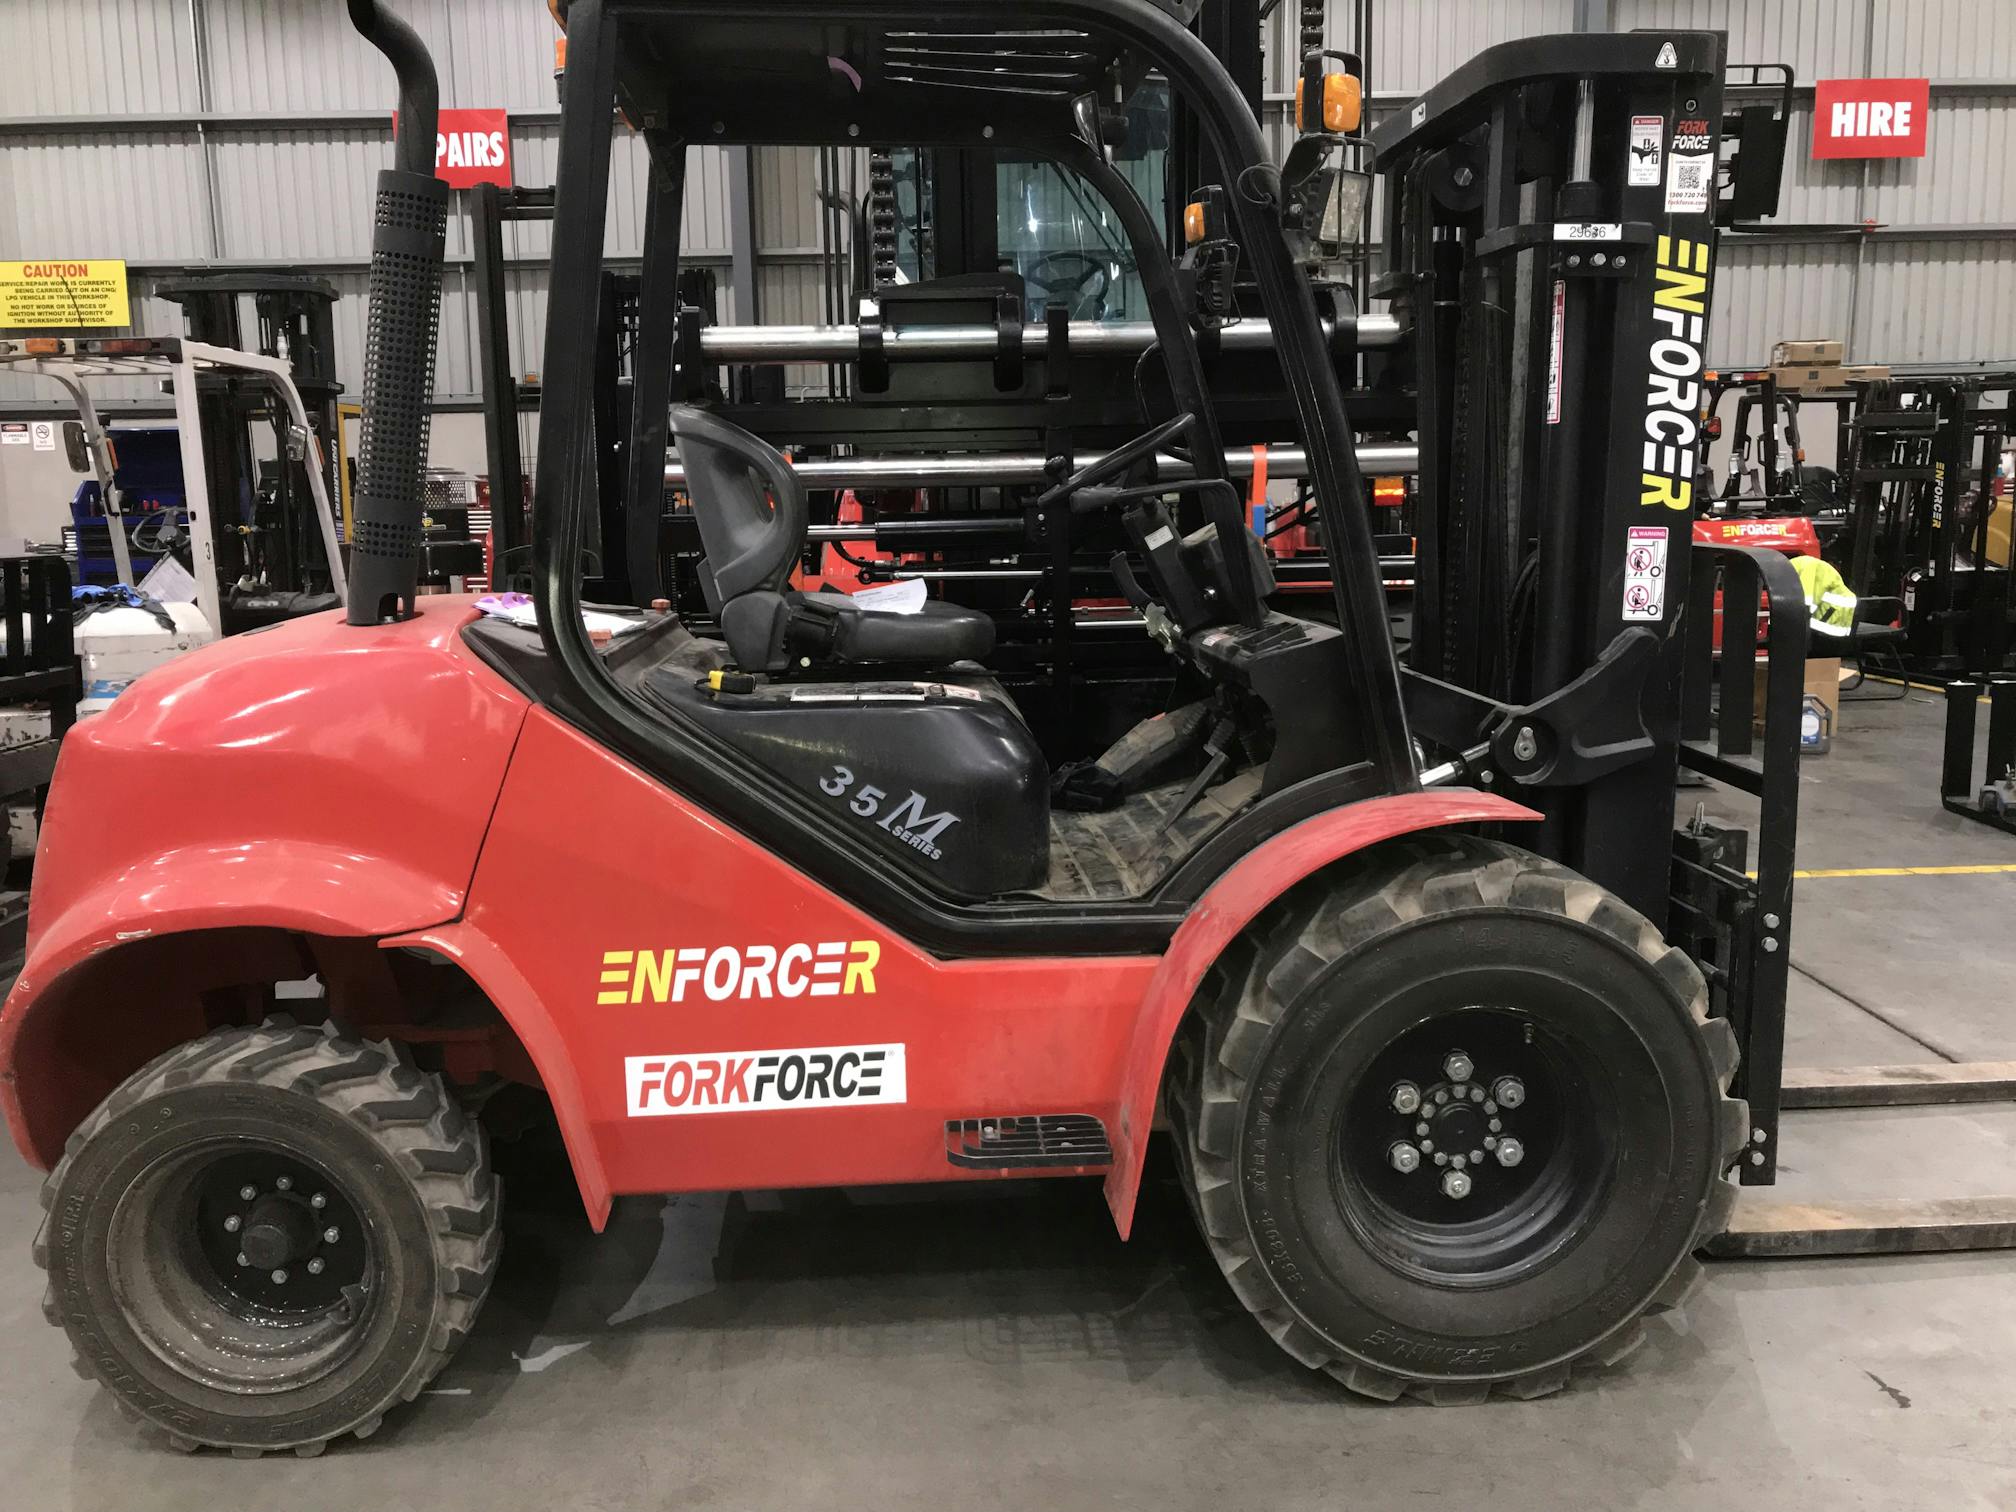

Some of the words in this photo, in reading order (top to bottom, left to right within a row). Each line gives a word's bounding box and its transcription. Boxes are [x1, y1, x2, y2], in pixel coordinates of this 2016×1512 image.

[1676, 120, 1709, 134] FORK
[1830, 101, 1912, 137] HIRE
[1672, 135, 1711, 150] FORCE
[23, 264, 88, 278] CAUTION
[1641, 234, 1709, 511] ENFORCER
[1932, 461, 1945, 529] ENFORCER
[1638, 530, 1666, 538] WARNING
[1721, 523, 1788, 538] ENFORCER
[891, 824, 943, 861] SERIES
[596, 939, 881, 1005] ENFORCER
[638, 1050, 886, 1109] FORKFORCE
